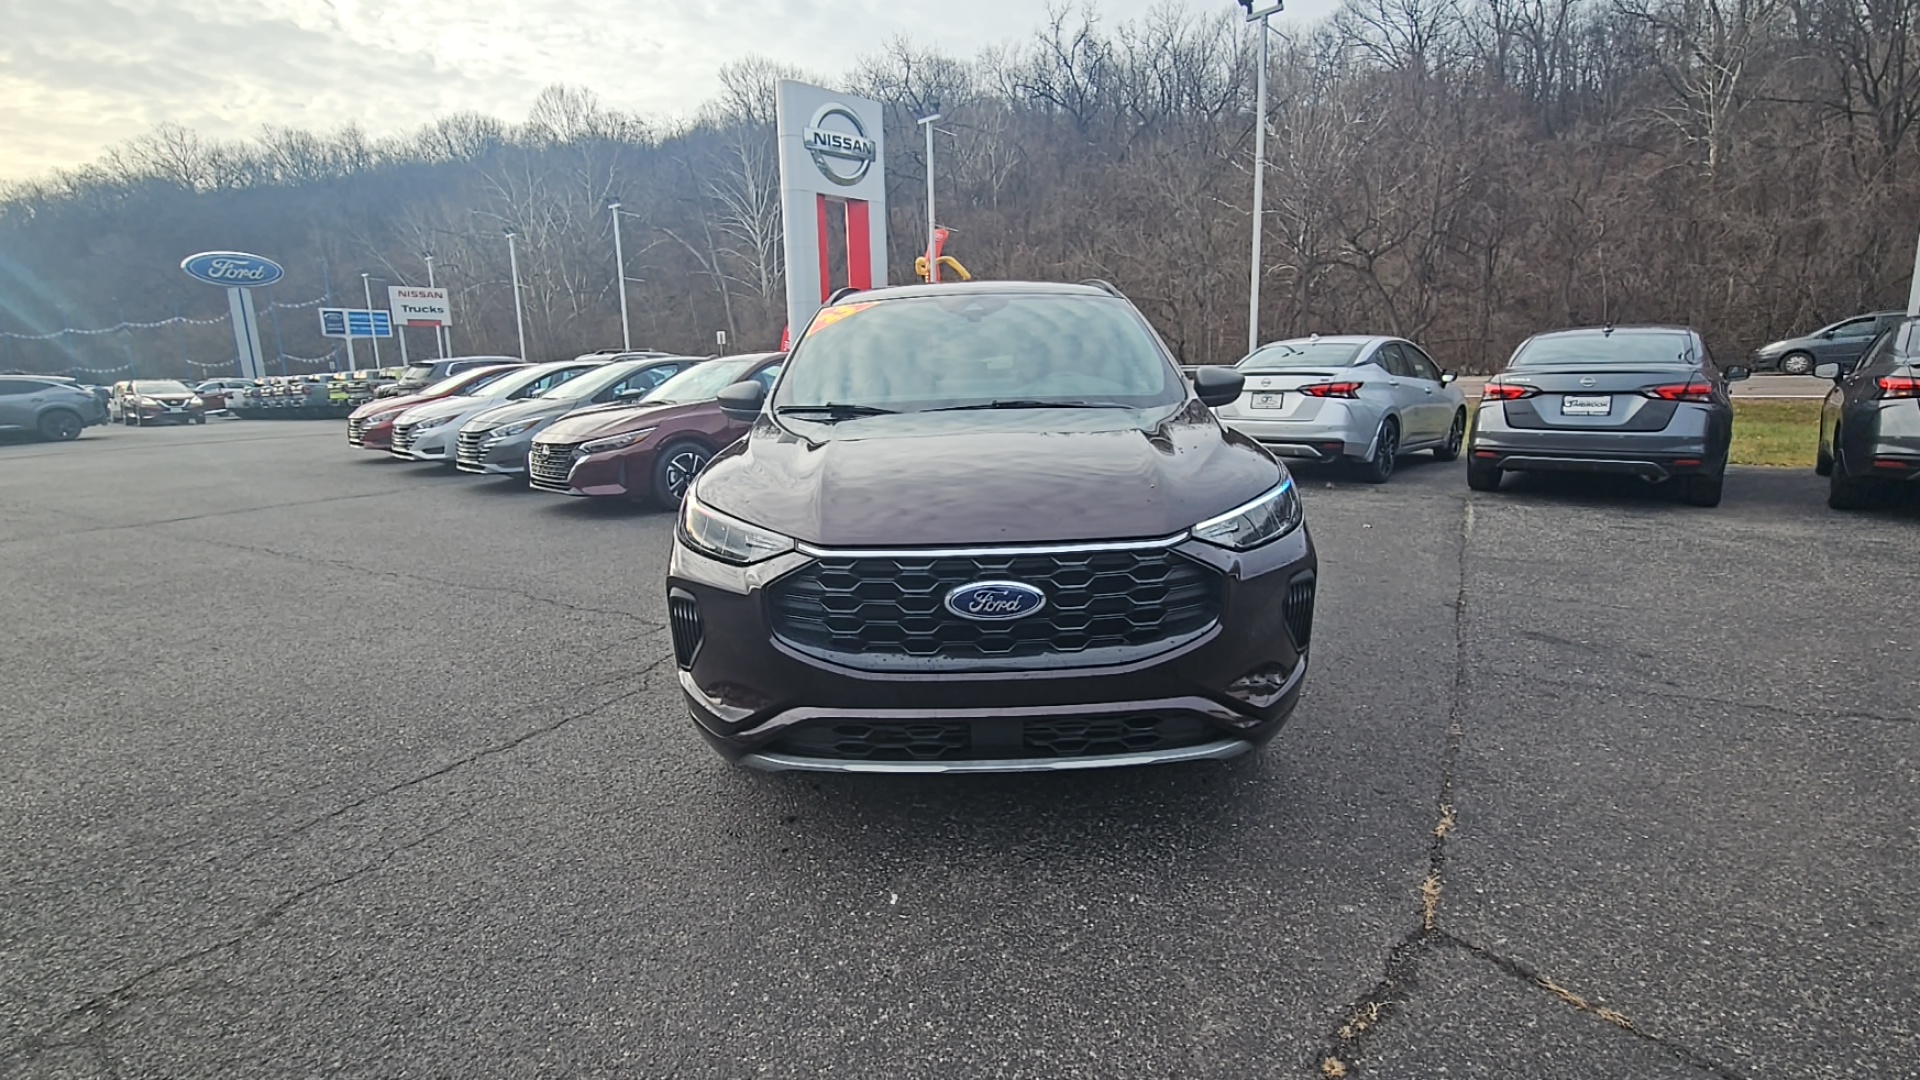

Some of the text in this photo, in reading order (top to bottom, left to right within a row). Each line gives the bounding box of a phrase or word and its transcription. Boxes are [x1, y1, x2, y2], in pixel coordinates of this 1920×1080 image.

[813, 131, 872, 155] NISSAN
[208, 258, 264, 280] Ford
[397, 290, 443, 299] NISSAN
[401, 304, 444, 314] Trucks
[969, 590, 1023, 612] Ford
